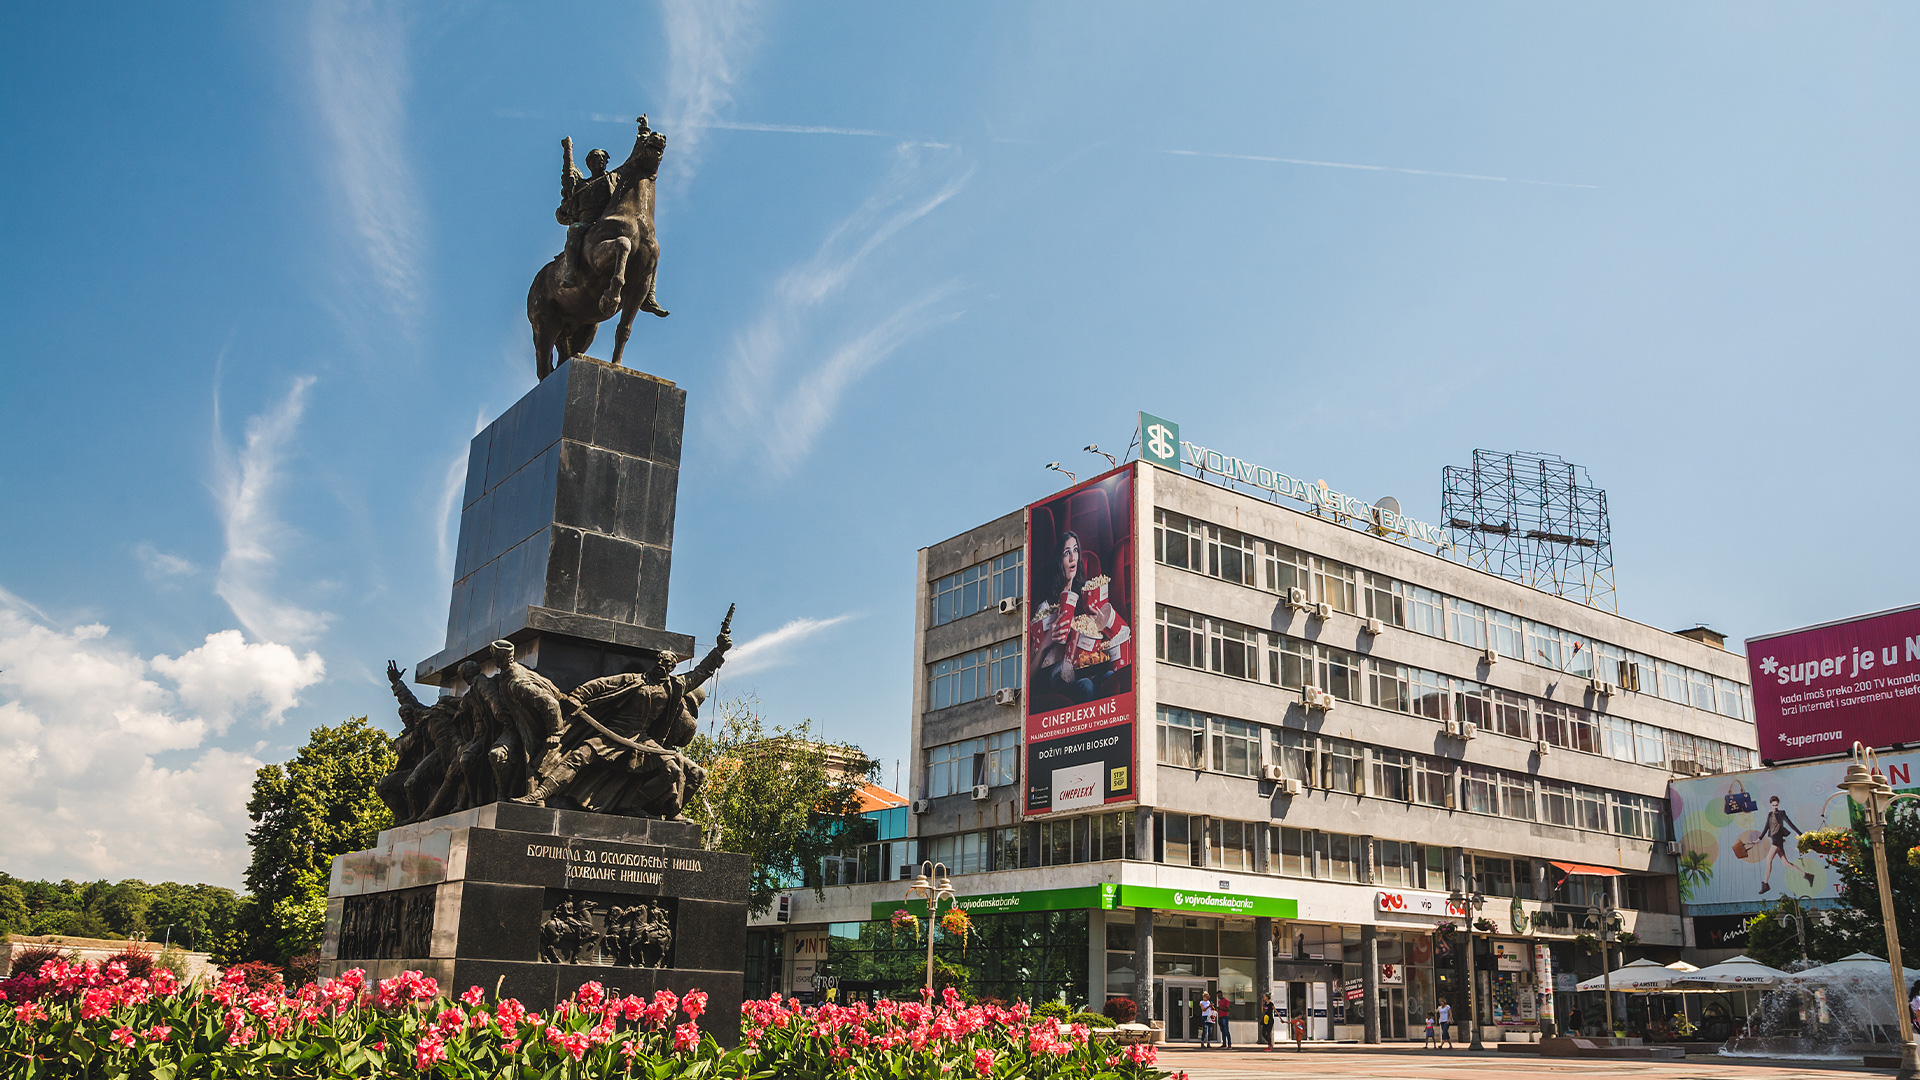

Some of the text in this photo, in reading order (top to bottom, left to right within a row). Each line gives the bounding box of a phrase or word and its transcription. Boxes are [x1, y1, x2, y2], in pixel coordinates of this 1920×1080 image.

[1185, 441, 1454, 551] VOJVOĐANSKA BANKA
[1850, 646, 1875, 678] je
[1882, 645, 1898, 666] u
[1780, 693, 1802, 705] kada
[1803, 688, 1825, 700] imaš
[1826, 685, 1853, 698] preko
[1854, 680, 1872, 693] 200
[1873, 678, 1885, 689] TV
[1041, 698, 1117, 728] CINEPLEXX NIŠ
[1781, 706, 1798, 716] brzi
[1799, 699, 1835, 714] internet
[1836, 698, 1840, 708] i
[1841, 691, 1893, 707] savremenu
[1066, 723, 1088, 734] BIOSKOP
[1088, 721, 1093, 729] U
[1093, 718, 1108, 728] TVOM
[1038, 735, 1119, 760] DOŽIVI PRAVI BIOSKOP
[1113, 770, 1125, 779] STOP
[1059, 782, 1096, 801] CINEPLEXX
[583, 849, 597, 863] ЗА
[600, 851, 669, 869] ОСЛОБОЂЕЊЕ
[672, 858, 703, 872] НИША
[1184, 894, 1254, 909] vojvođanskabanka
[1421, 899, 1432, 911] vip
[1394, 974, 1402, 982] vip
